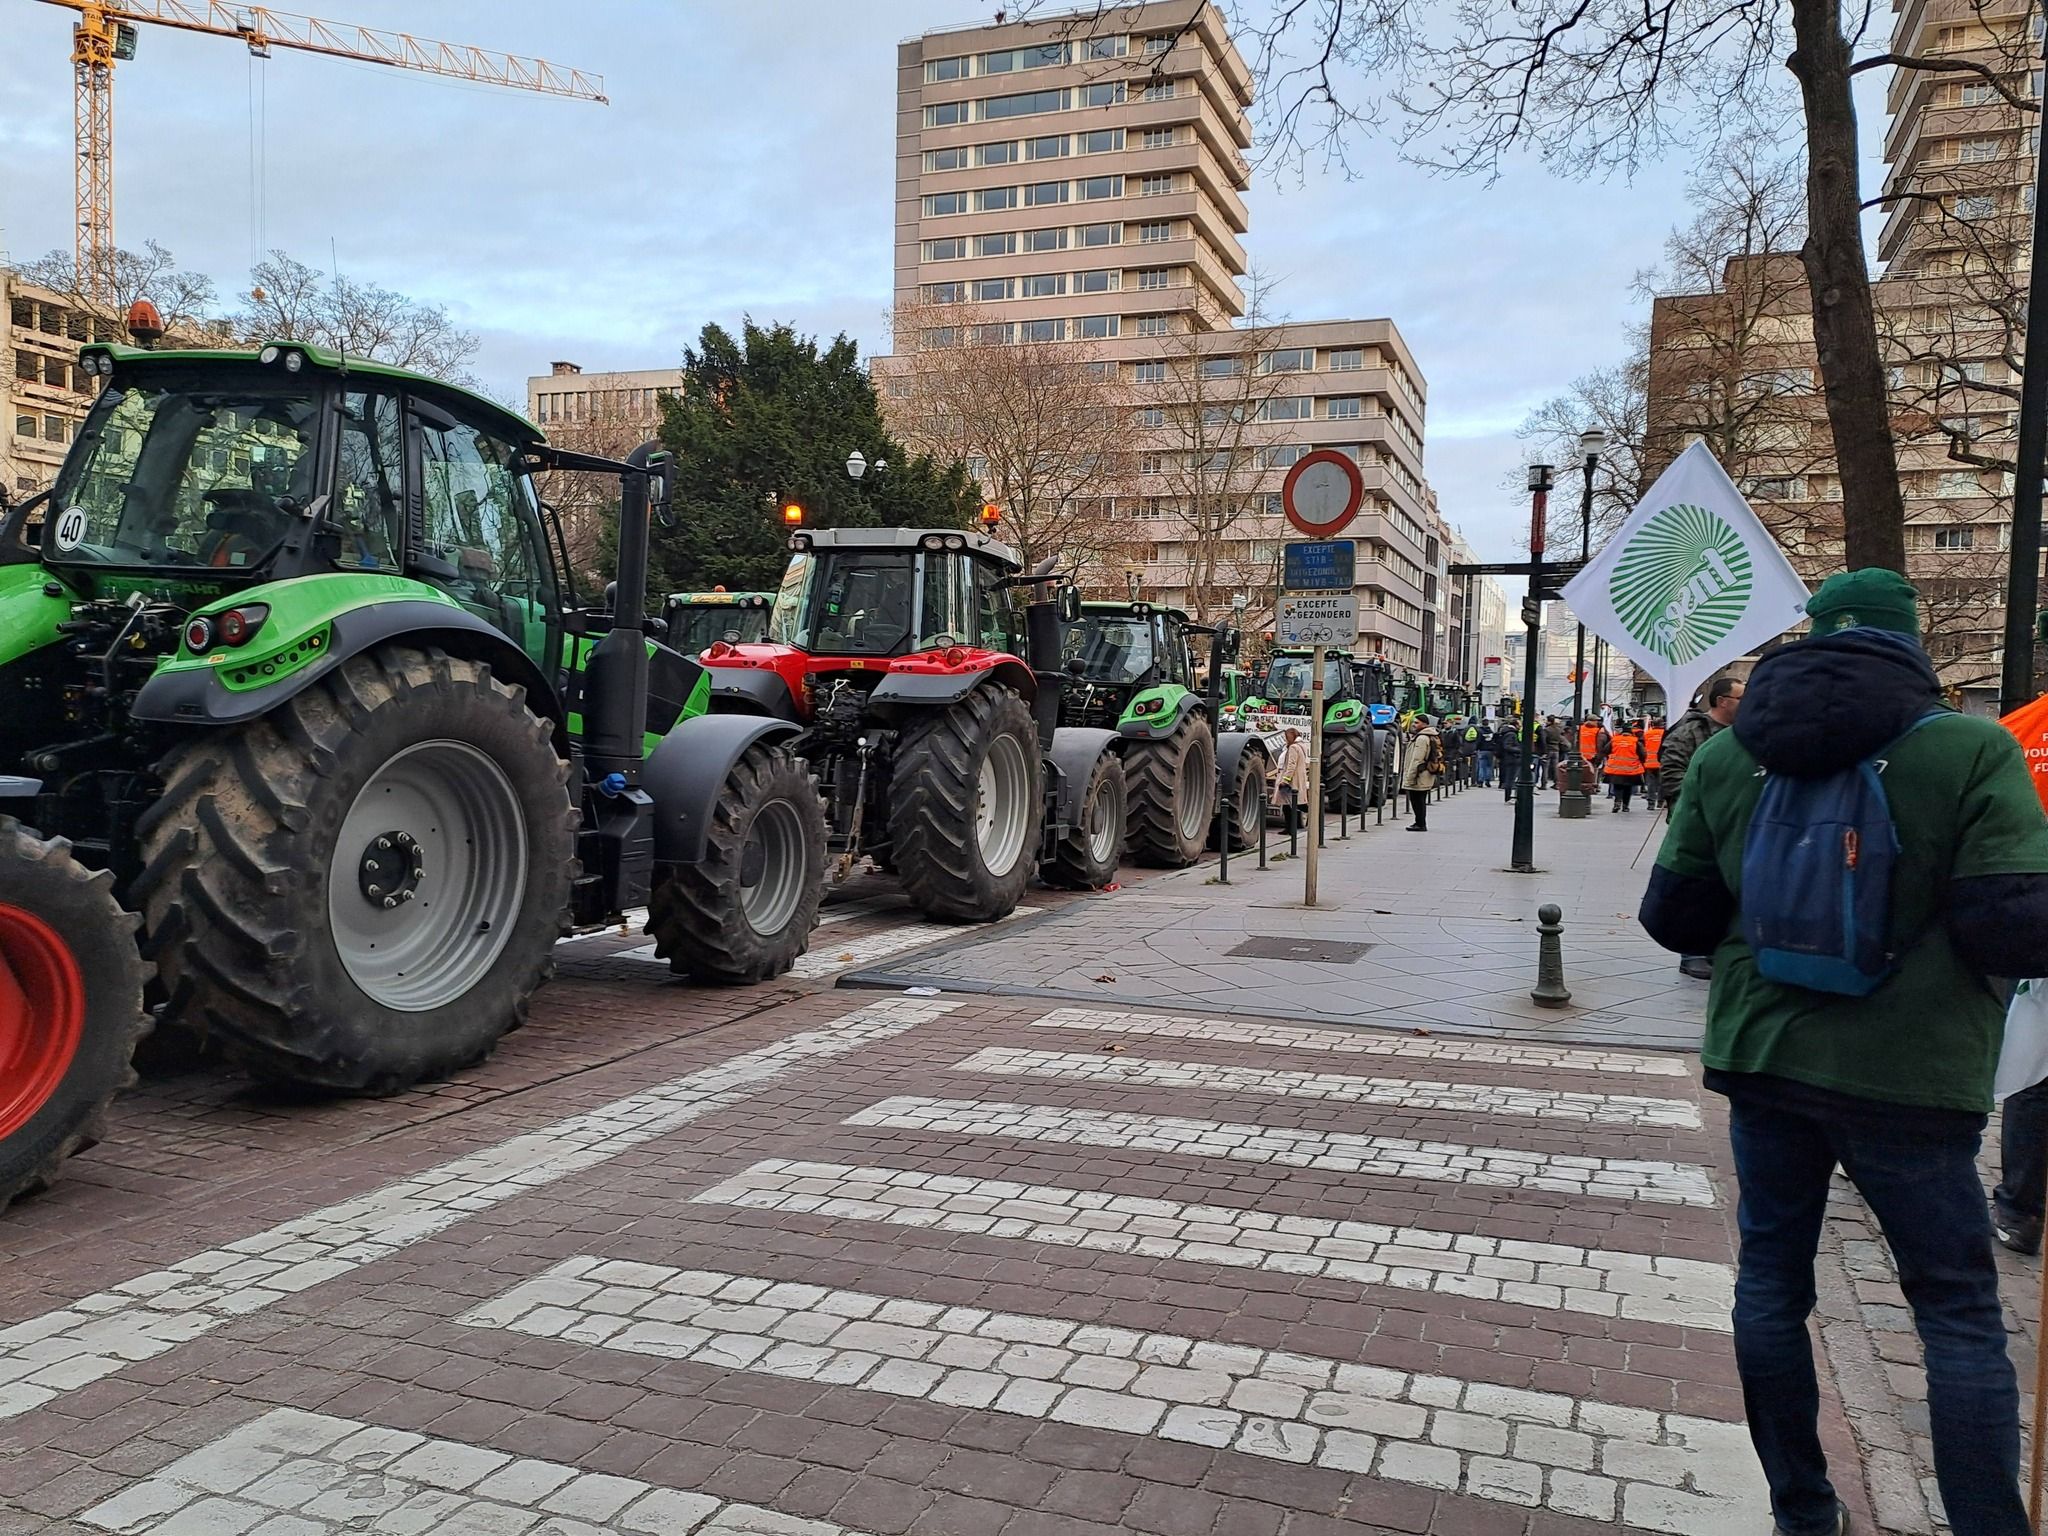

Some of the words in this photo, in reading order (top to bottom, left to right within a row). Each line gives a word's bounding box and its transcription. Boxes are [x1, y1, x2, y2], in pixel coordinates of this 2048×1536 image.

[60, 515, 82, 542] 40
[1303, 545, 1336, 554] EXCEPTE
[1297, 600, 1338, 608] EXCEPTE
[1284, 610, 1351, 619] GEZONDERD
